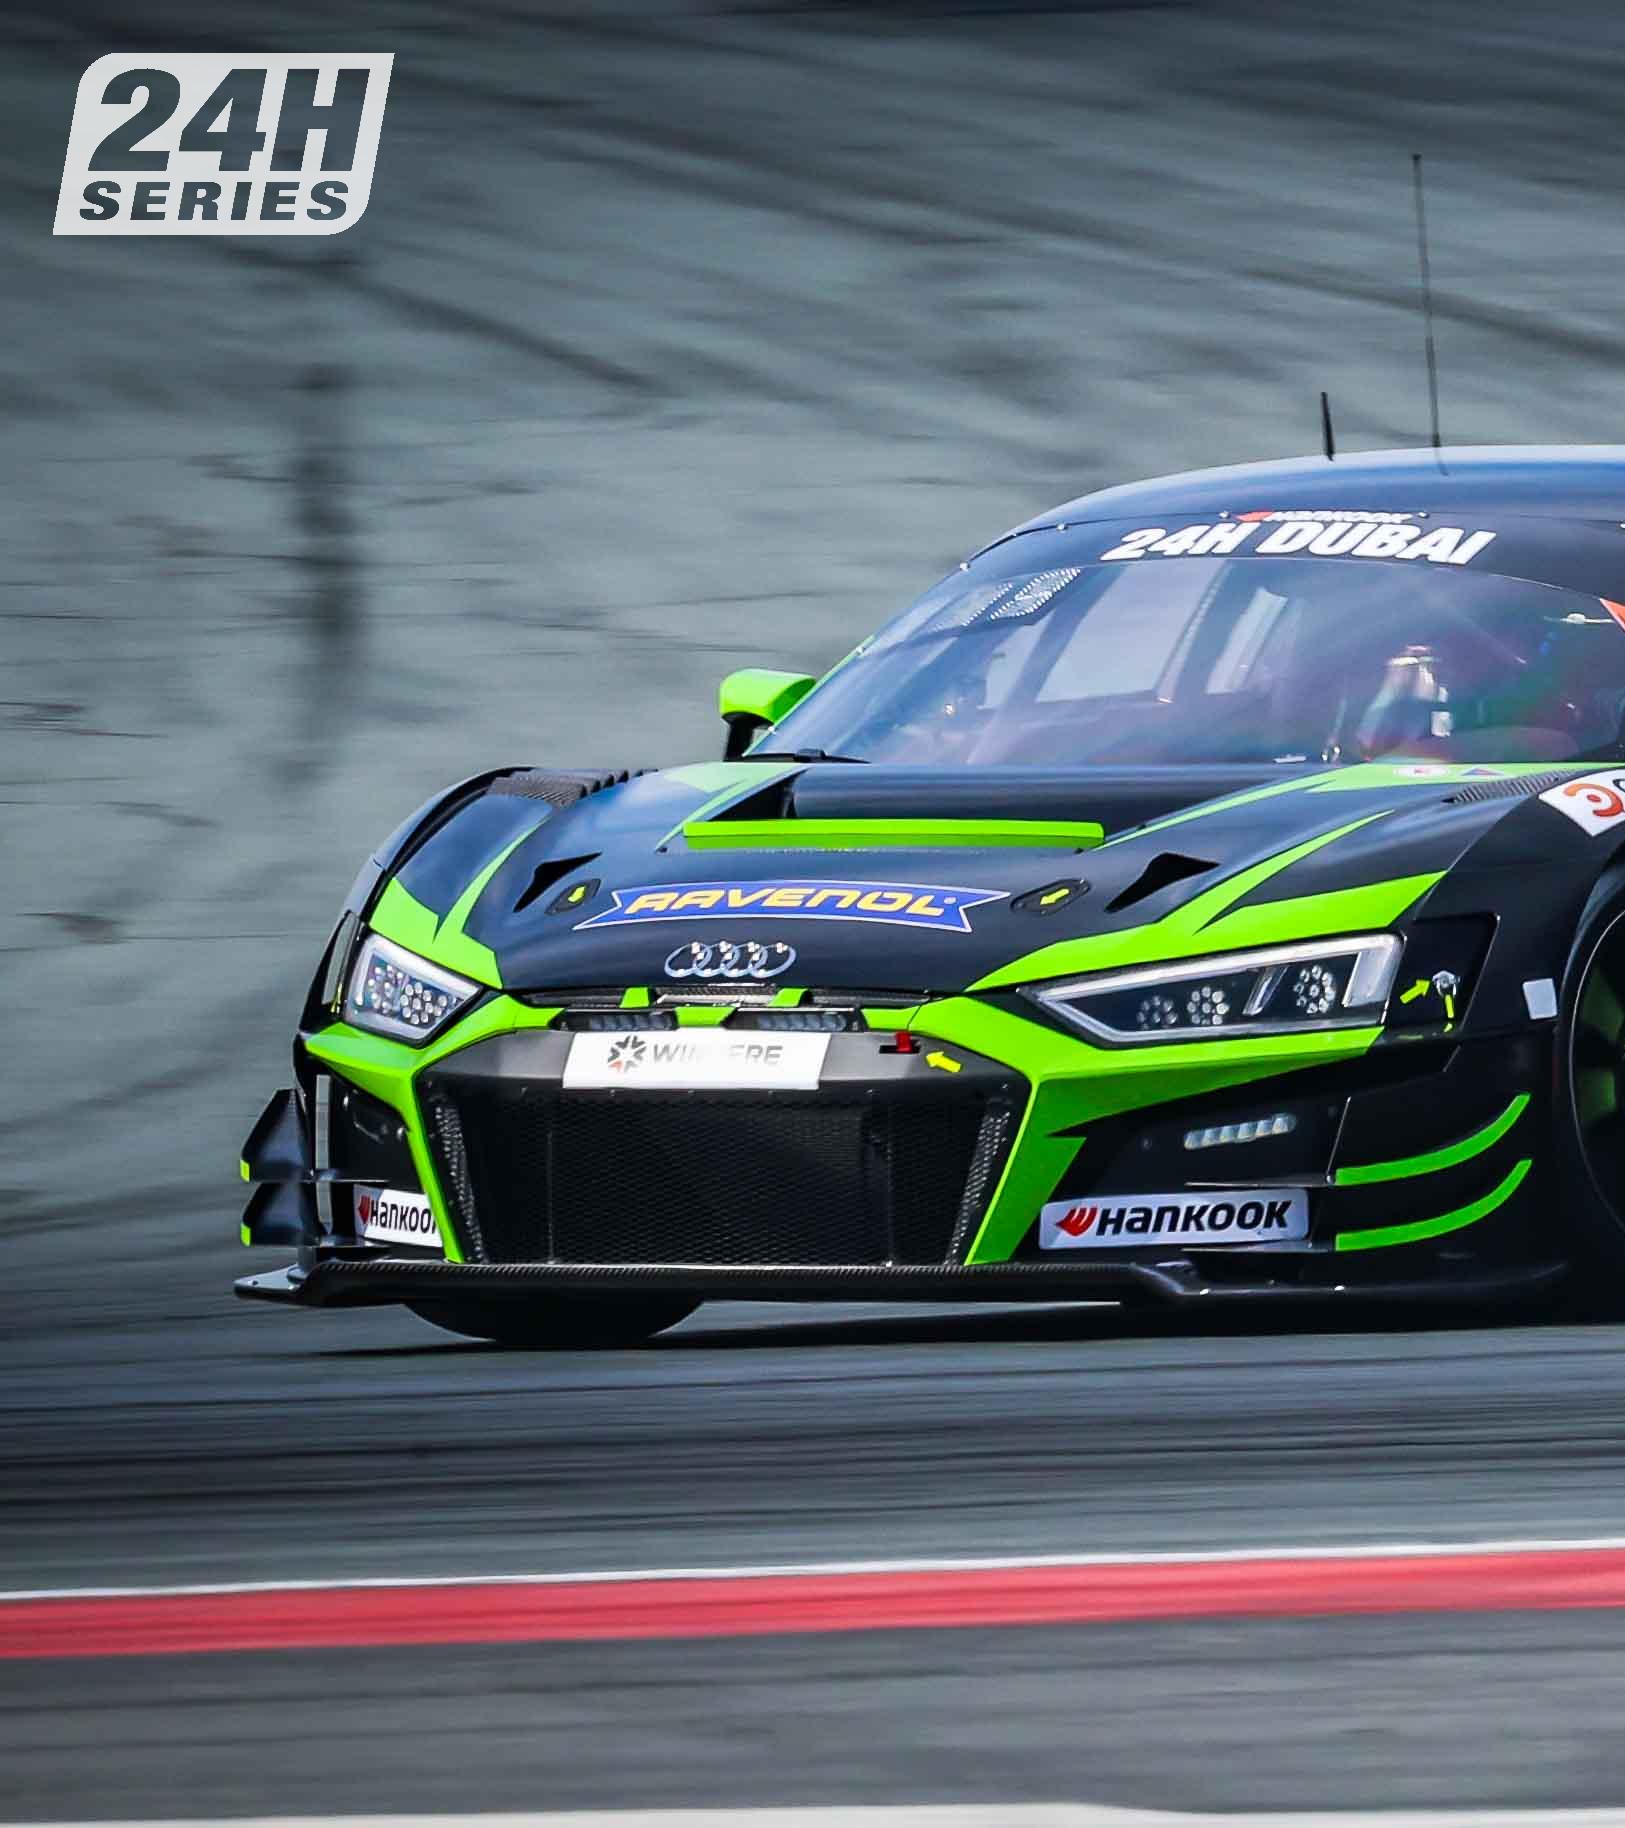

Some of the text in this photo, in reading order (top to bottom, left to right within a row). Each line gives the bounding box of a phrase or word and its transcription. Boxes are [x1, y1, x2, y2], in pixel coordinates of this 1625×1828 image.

[1100, 520, 1498, 565] 24H DUBAI
[623, 887, 948, 917] RAVENOL
[369, 1198, 437, 1235] HANKOO
